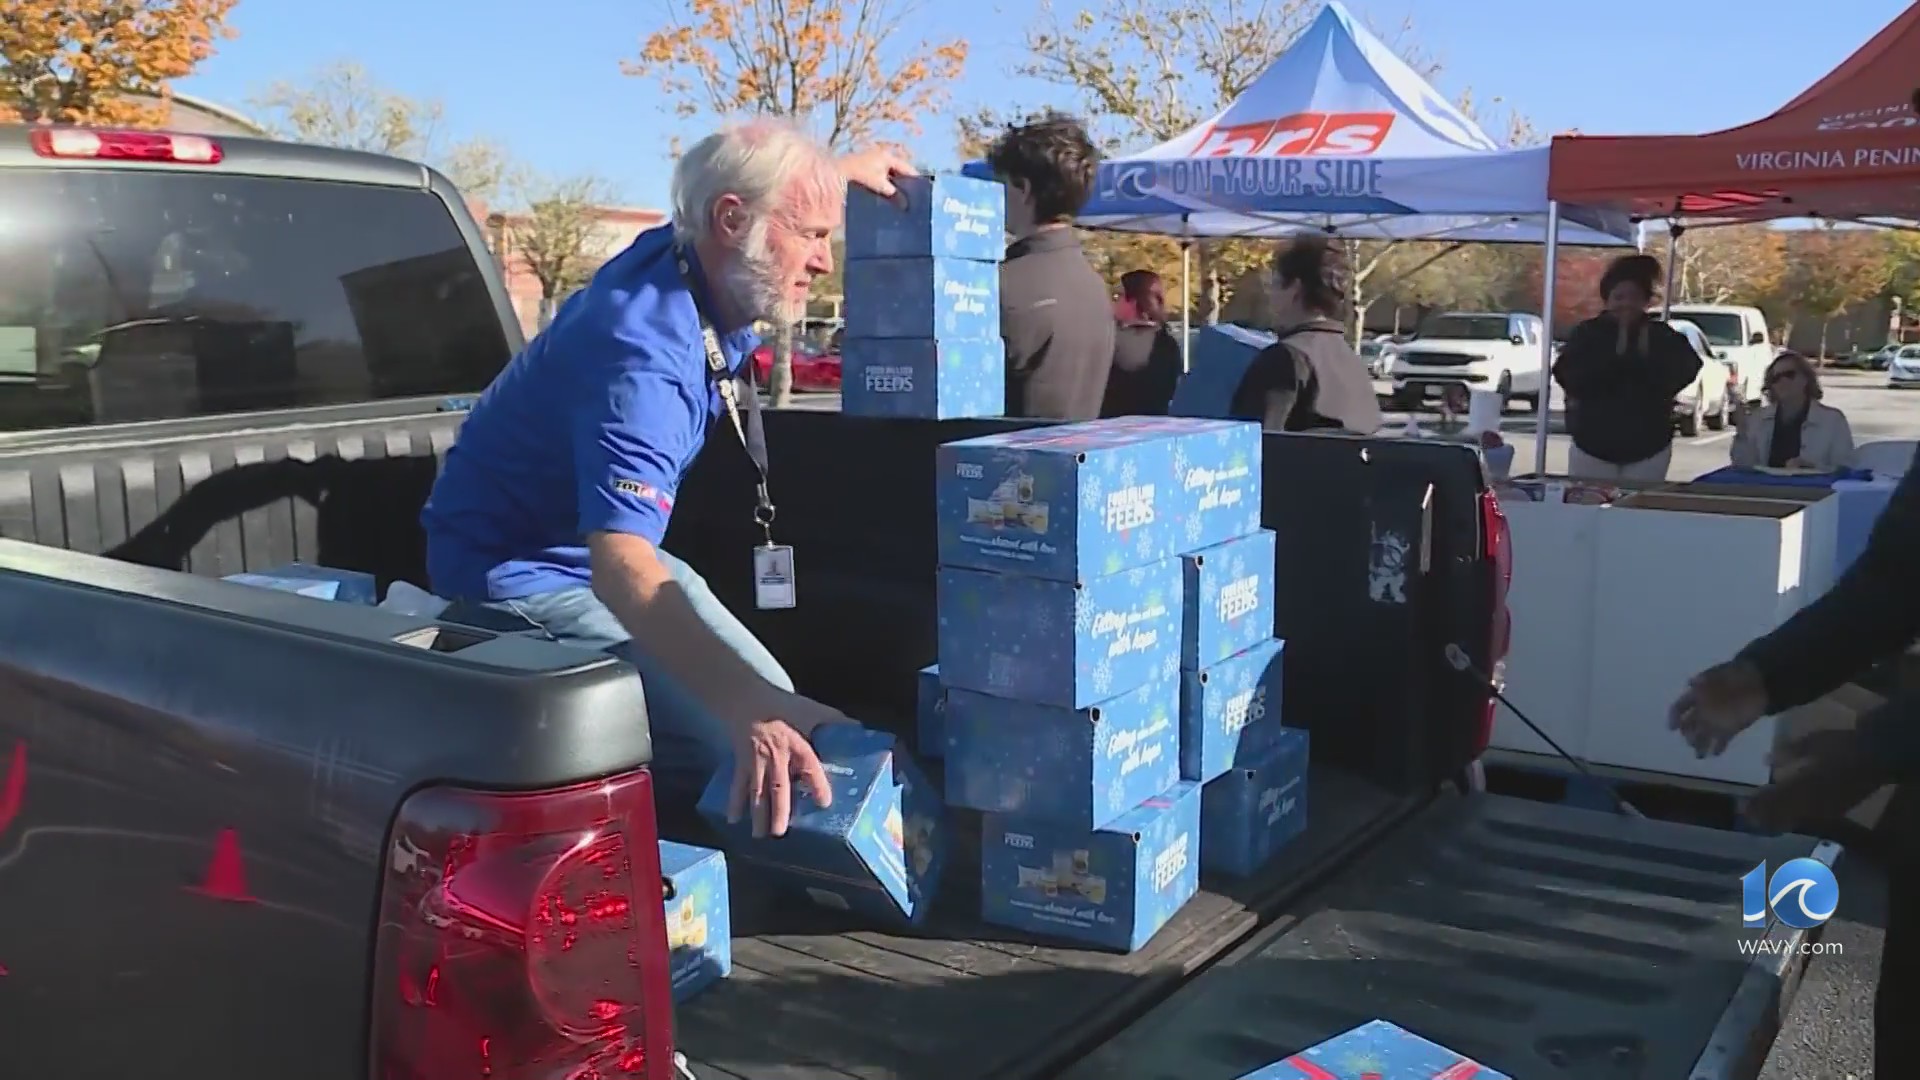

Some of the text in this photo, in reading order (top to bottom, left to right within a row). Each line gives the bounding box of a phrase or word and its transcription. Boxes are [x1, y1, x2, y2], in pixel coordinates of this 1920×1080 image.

[1171, 160, 1212, 196] ON
[1221, 156, 1304, 196] YOUR
[1314, 158, 1384, 197] SIDE
[1736, 150, 1845, 170] VIRGINIA
[865, 376, 913, 392] FEEDS
[1107, 501, 1155, 533] FEEDS
[1220, 589, 1258, 623] FEEDS
[1225, 700, 1265, 735] FEEDS
[1155, 848, 1187, 893] FEEDS
